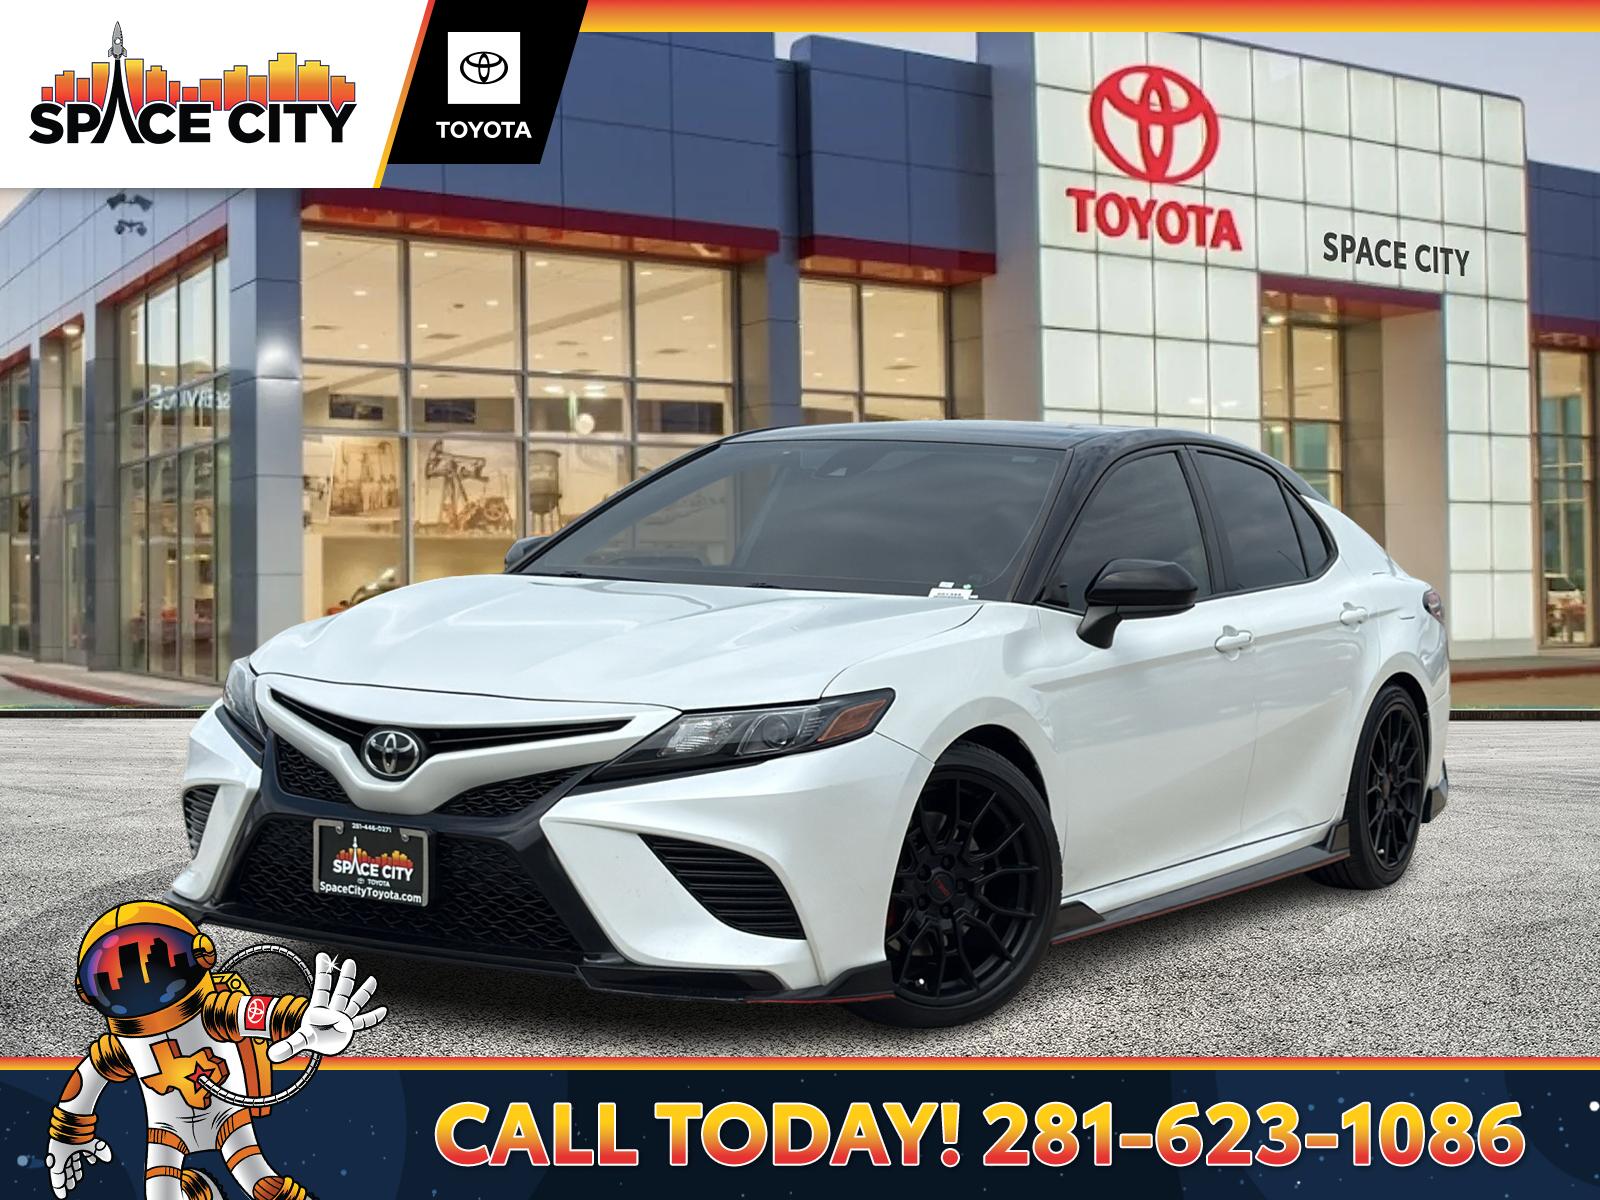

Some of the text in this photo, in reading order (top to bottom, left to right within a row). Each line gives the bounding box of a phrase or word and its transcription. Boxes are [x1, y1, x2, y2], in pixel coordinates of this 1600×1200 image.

[1066, 187, 1242, 251] TOYOTA
[1322, 231, 1470, 277] SPACE CITY
[332, 847, 414, 882] SPACE CITY
[319, 881, 422, 904] SpaceCityToyota.com
[367, 878, 391, 888] TOYOTA
